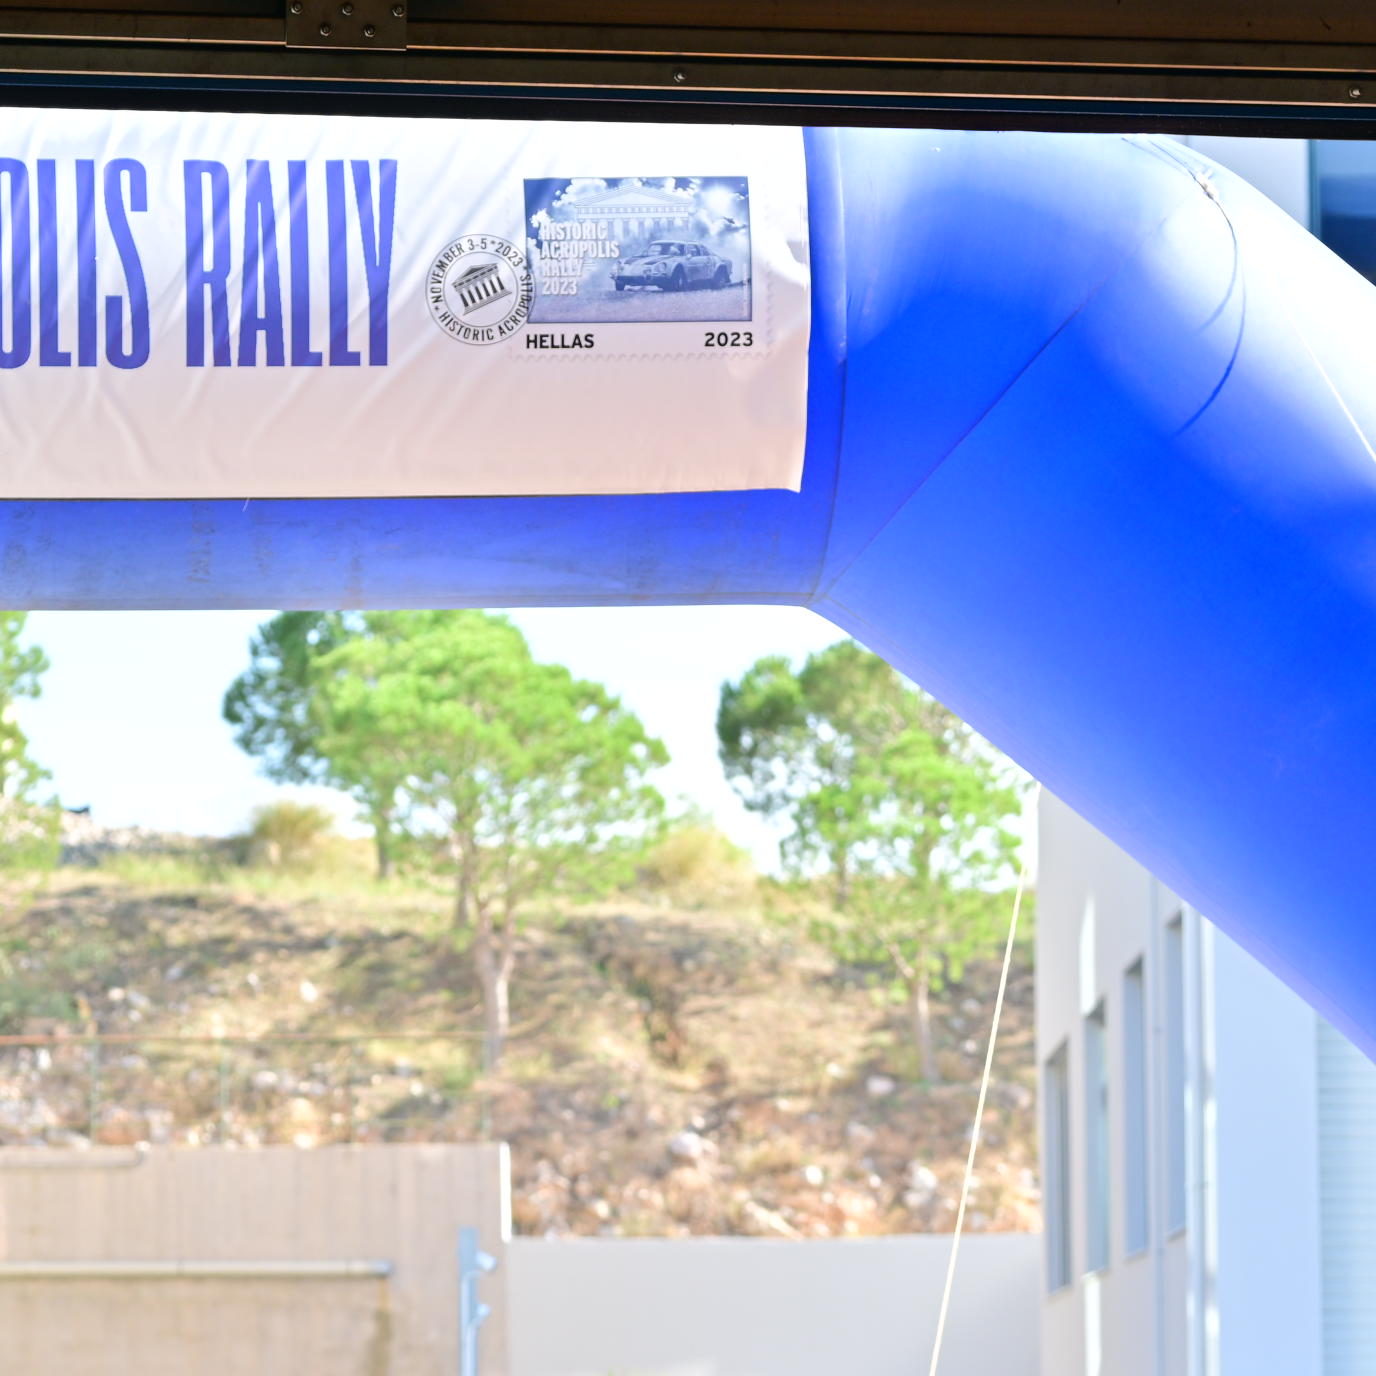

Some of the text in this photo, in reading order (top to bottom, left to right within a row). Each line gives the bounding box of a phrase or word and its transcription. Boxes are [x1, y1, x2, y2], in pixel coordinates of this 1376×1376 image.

[542, 221, 609, 240] HISTORIC
[541, 241, 621, 258] ACROPOLIS
[183, 158, 398, 368] RALLY
[430, 238, 524, 304] NOVEMBER 3-5 2023
[543, 259, 584, 276] RALLY
[543, 277, 577, 295] 2023
[438, 273, 533, 342] HISTORIC ACROPOLIS
[526, 332, 754, 349] HELLAS 2023
